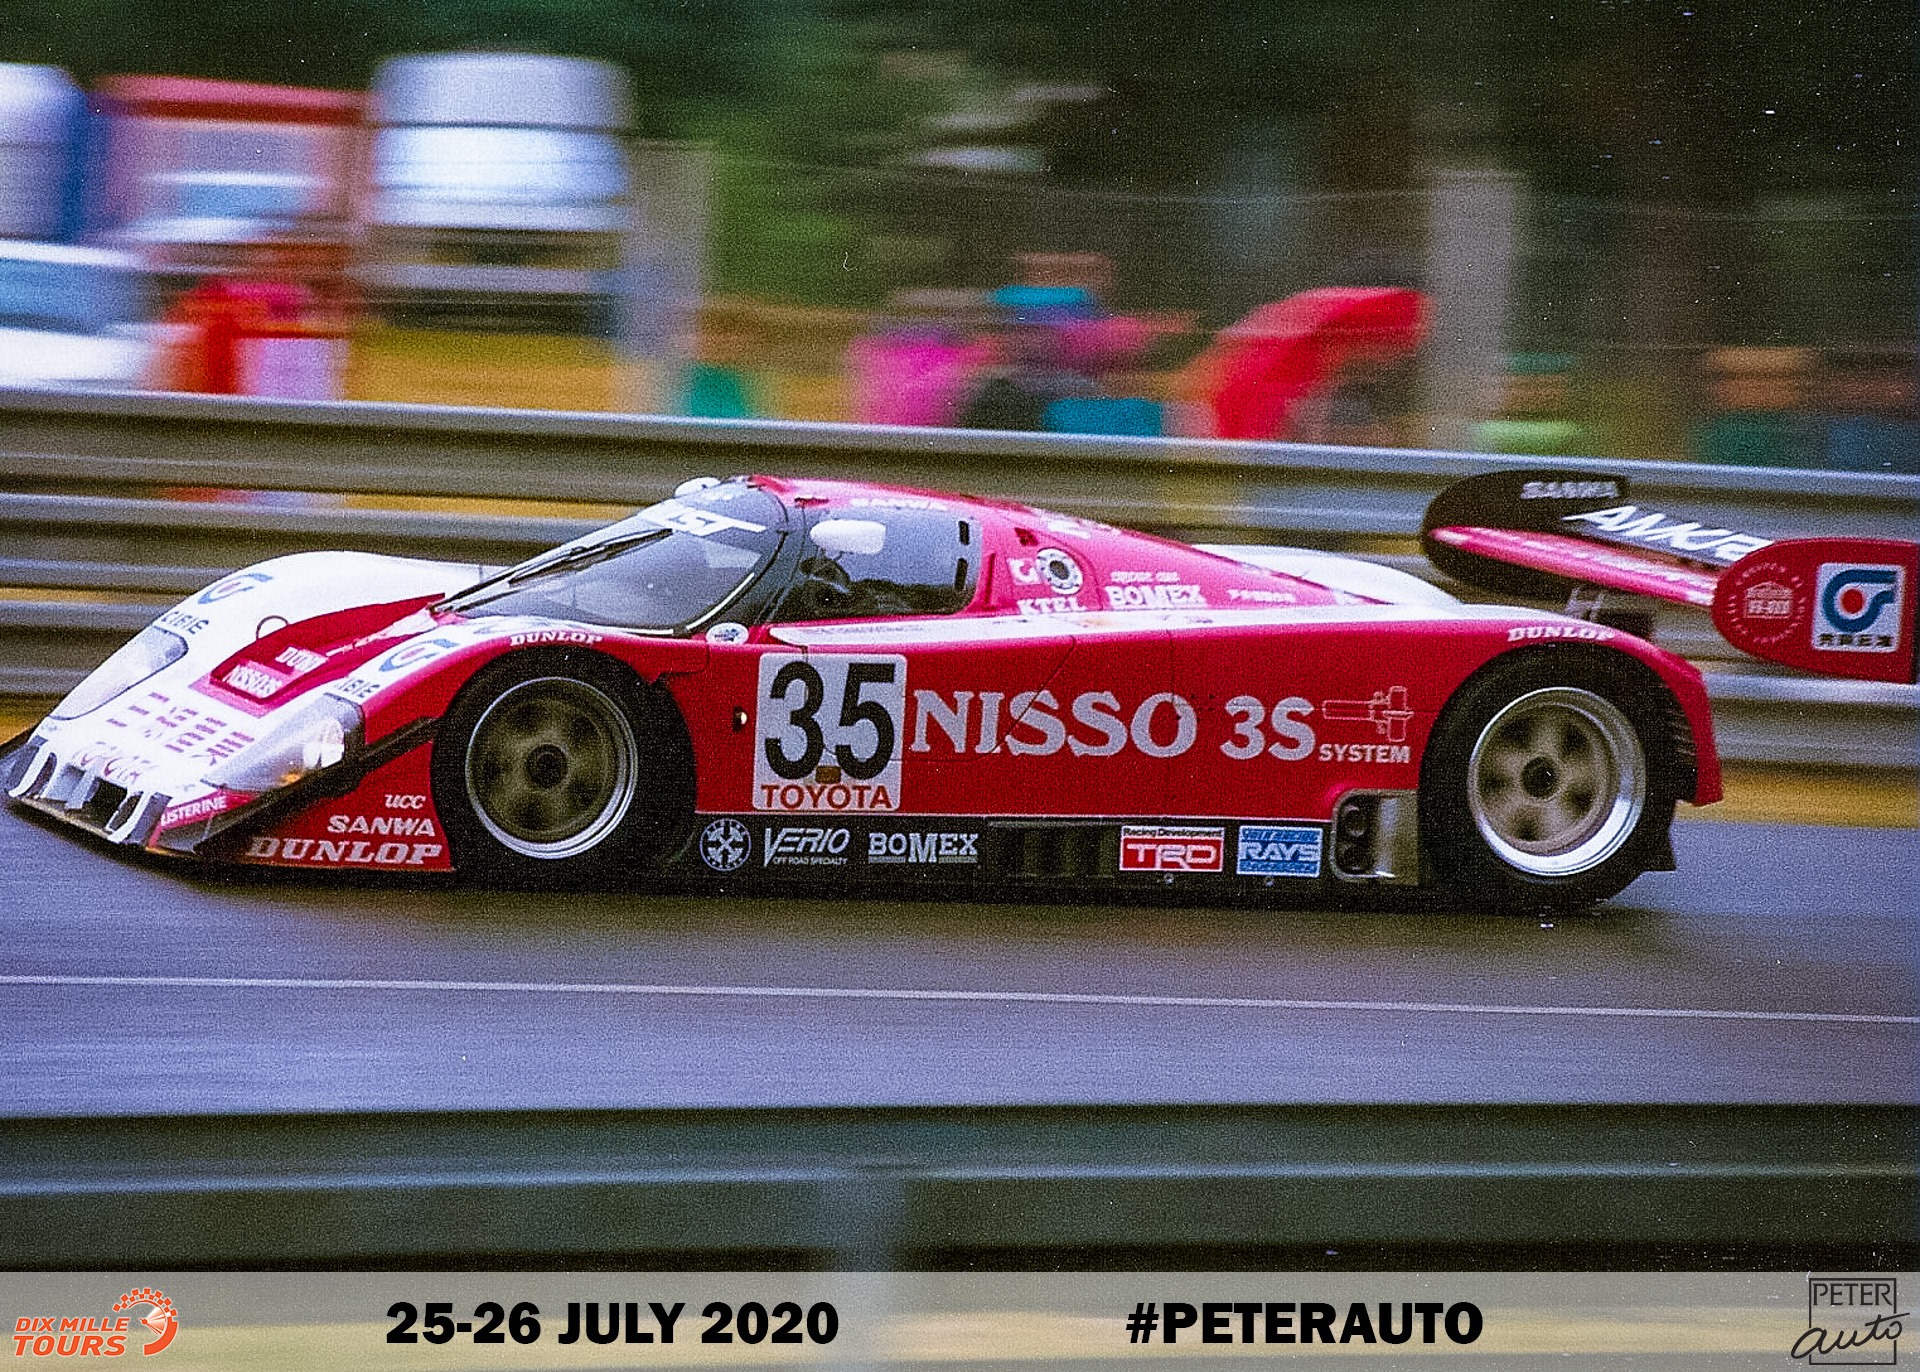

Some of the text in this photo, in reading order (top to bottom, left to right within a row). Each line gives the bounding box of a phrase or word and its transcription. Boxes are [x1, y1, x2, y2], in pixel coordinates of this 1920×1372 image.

[1104, 585, 1209, 609] BOMEX
[509, 630, 603, 647] DUNLOP
[1506, 625, 1616, 642] DUNLOP
[764, 660, 896, 779] 35
[910, 688, 1316, 761] NISSO 3S
[1318, 744, 1411, 764] SYSTEM
[760, 784, 893, 811] TOYOTA
[327, 814, 436, 836] SANWA
[248, 837, 441, 865] DUNLOP
[763, 827, 851, 867] VERIO
[868, 832, 979, 863] BOMEX
[1126, 843, 1217, 869] TRD
[1240, 842, 1322, 861] RAYS
